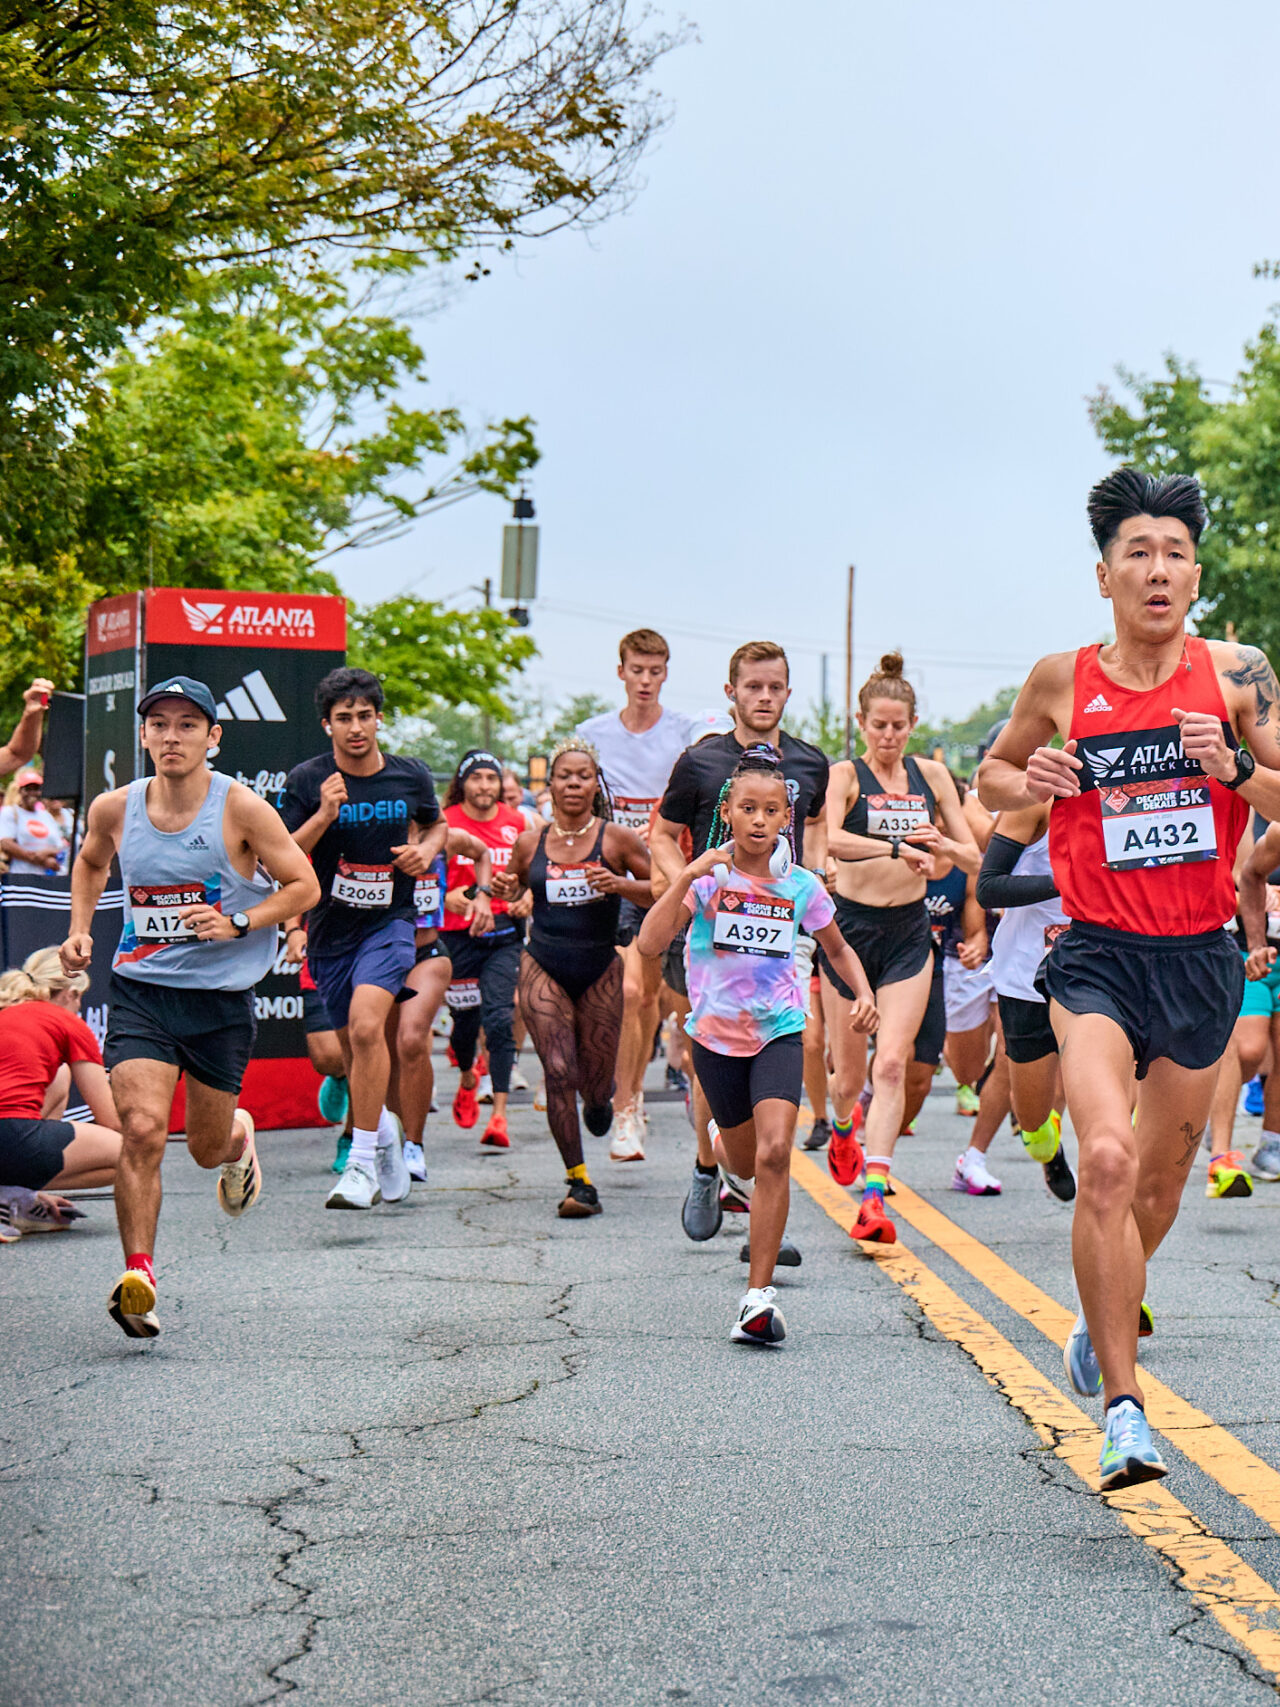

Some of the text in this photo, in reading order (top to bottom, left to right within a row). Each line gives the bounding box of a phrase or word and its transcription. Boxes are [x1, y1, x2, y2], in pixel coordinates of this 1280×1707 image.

[228, 606, 315, 628] ATLANTA
[229, 624, 315, 637] TRACK CLUB
[1083, 705, 1113, 714] adidas
[1130, 741, 1185, 766] ATLA
[1131, 757, 1198, 775] TRACK CL
[1136, 791, 1176, 805] DECATUR
[1143, 797, 1178, 811] DEKALB
[1179, 789, 1205, 806] 5K
[1123, 821, 1199, 852] A432
[183, 891, 203, 904] 5K
[338, 883, 386, 901] E2065
[416, 895, 433, 908] 59
[772, 906, 791, 919] 5K
[146, 916, 194, 932] A17
[726, 923, 782, 944] A397
